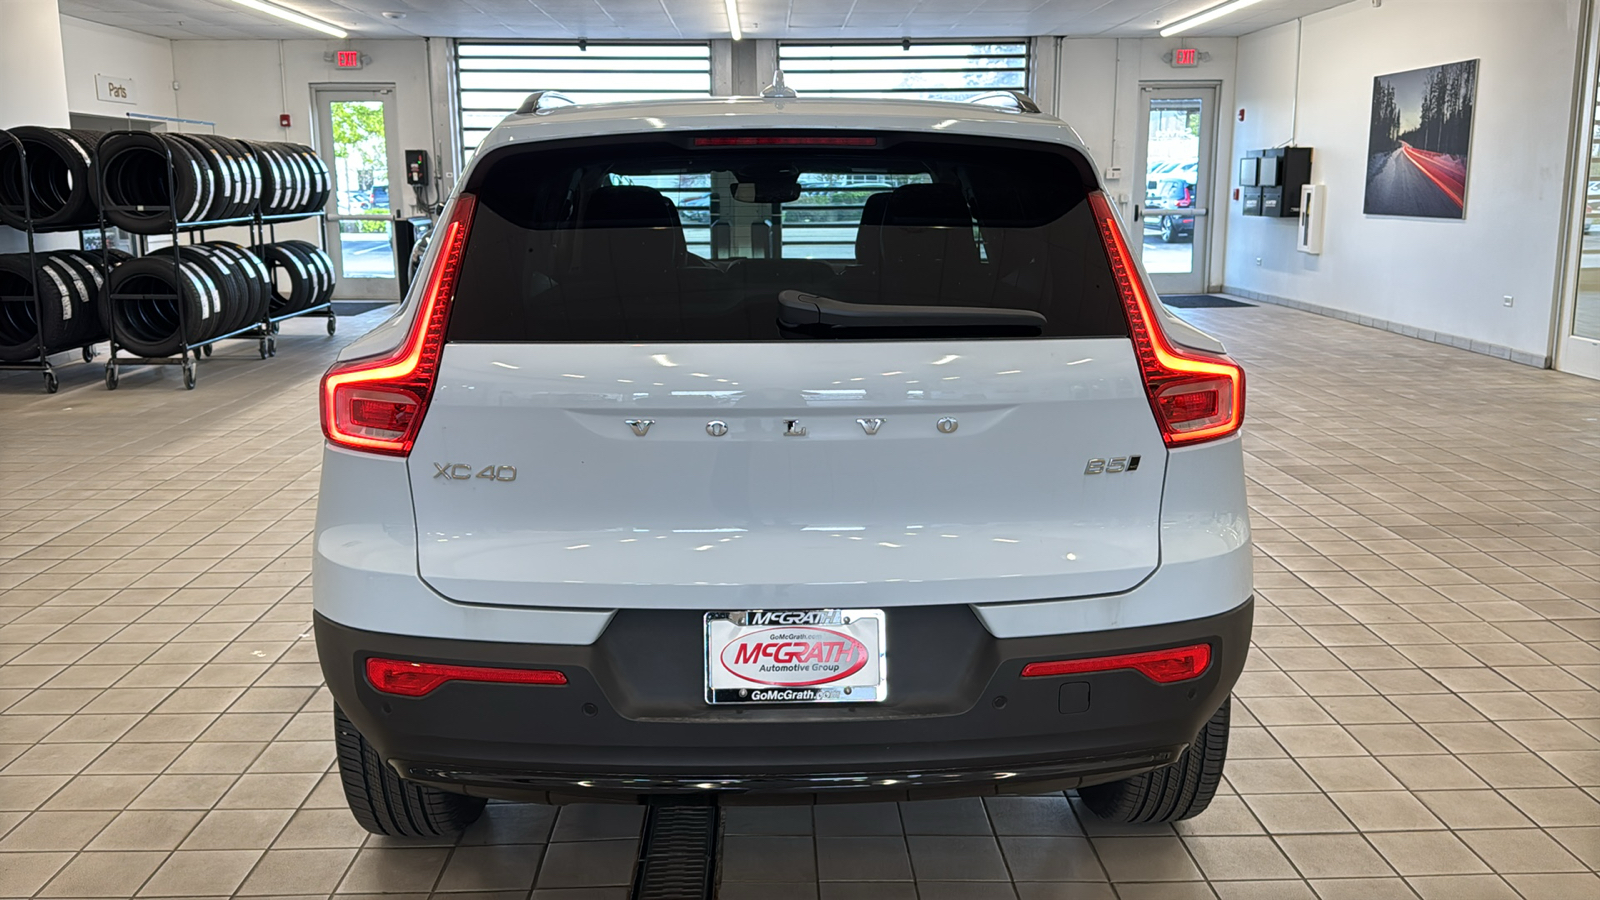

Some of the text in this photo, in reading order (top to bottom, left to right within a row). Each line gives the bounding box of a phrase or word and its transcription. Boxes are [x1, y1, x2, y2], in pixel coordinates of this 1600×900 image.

[337, 51, 357, 67] EXIT
[1176, 49, 1195, 64] EXIT
[108, 82, 127, 99] Parts
[624, 416, 959, 437] VOLVO
[1084, 456, 1127, 475] B5
[769, 633, 823, 641] GoMcGrath.com
[758, 663, 840, 673] Automotive Group
[751, 689, 841, 701] GoMcGrath.com
